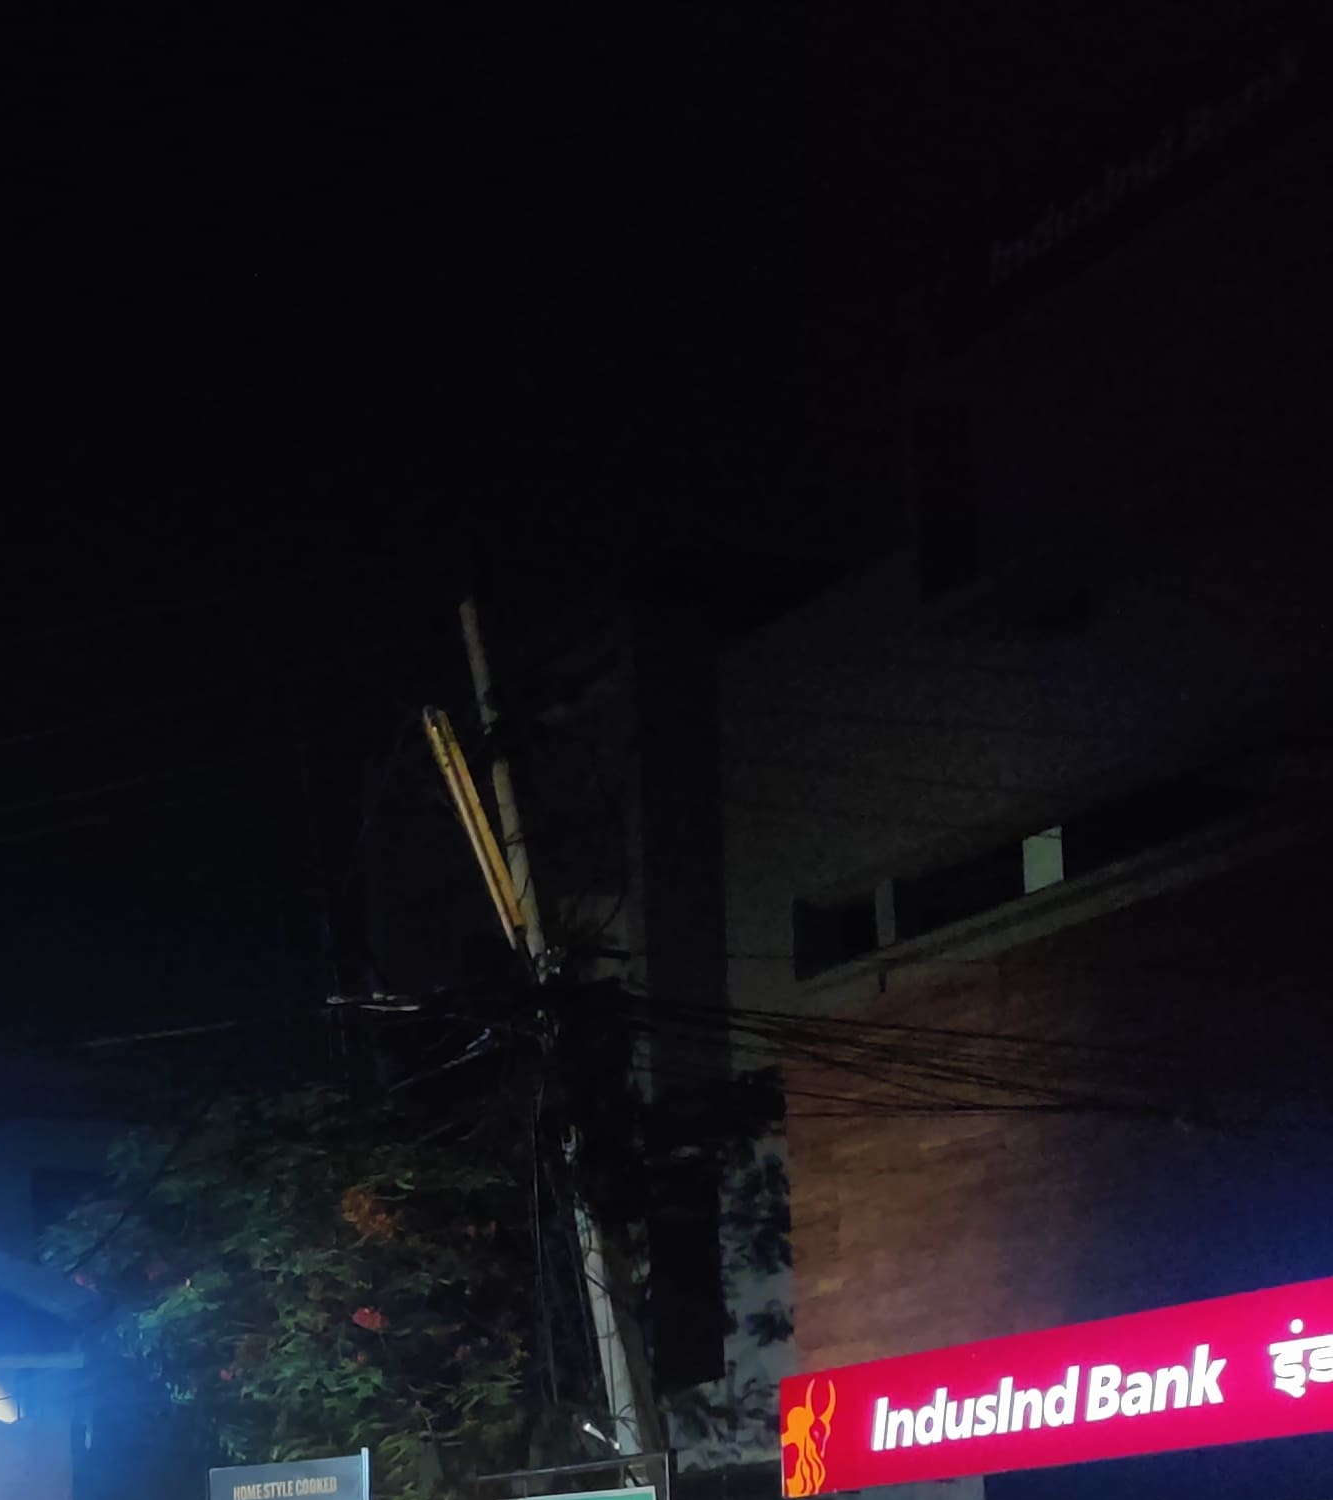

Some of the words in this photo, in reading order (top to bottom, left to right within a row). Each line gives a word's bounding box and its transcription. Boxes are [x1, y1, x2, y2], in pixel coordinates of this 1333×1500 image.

[872, 1365, 1081, 1452] IndusInd
[1085, 1344, 1228, 1422] Bank
[263, 1480, 294, 1499] STYLE
[295, 1476, 338, 1496] COOKED
